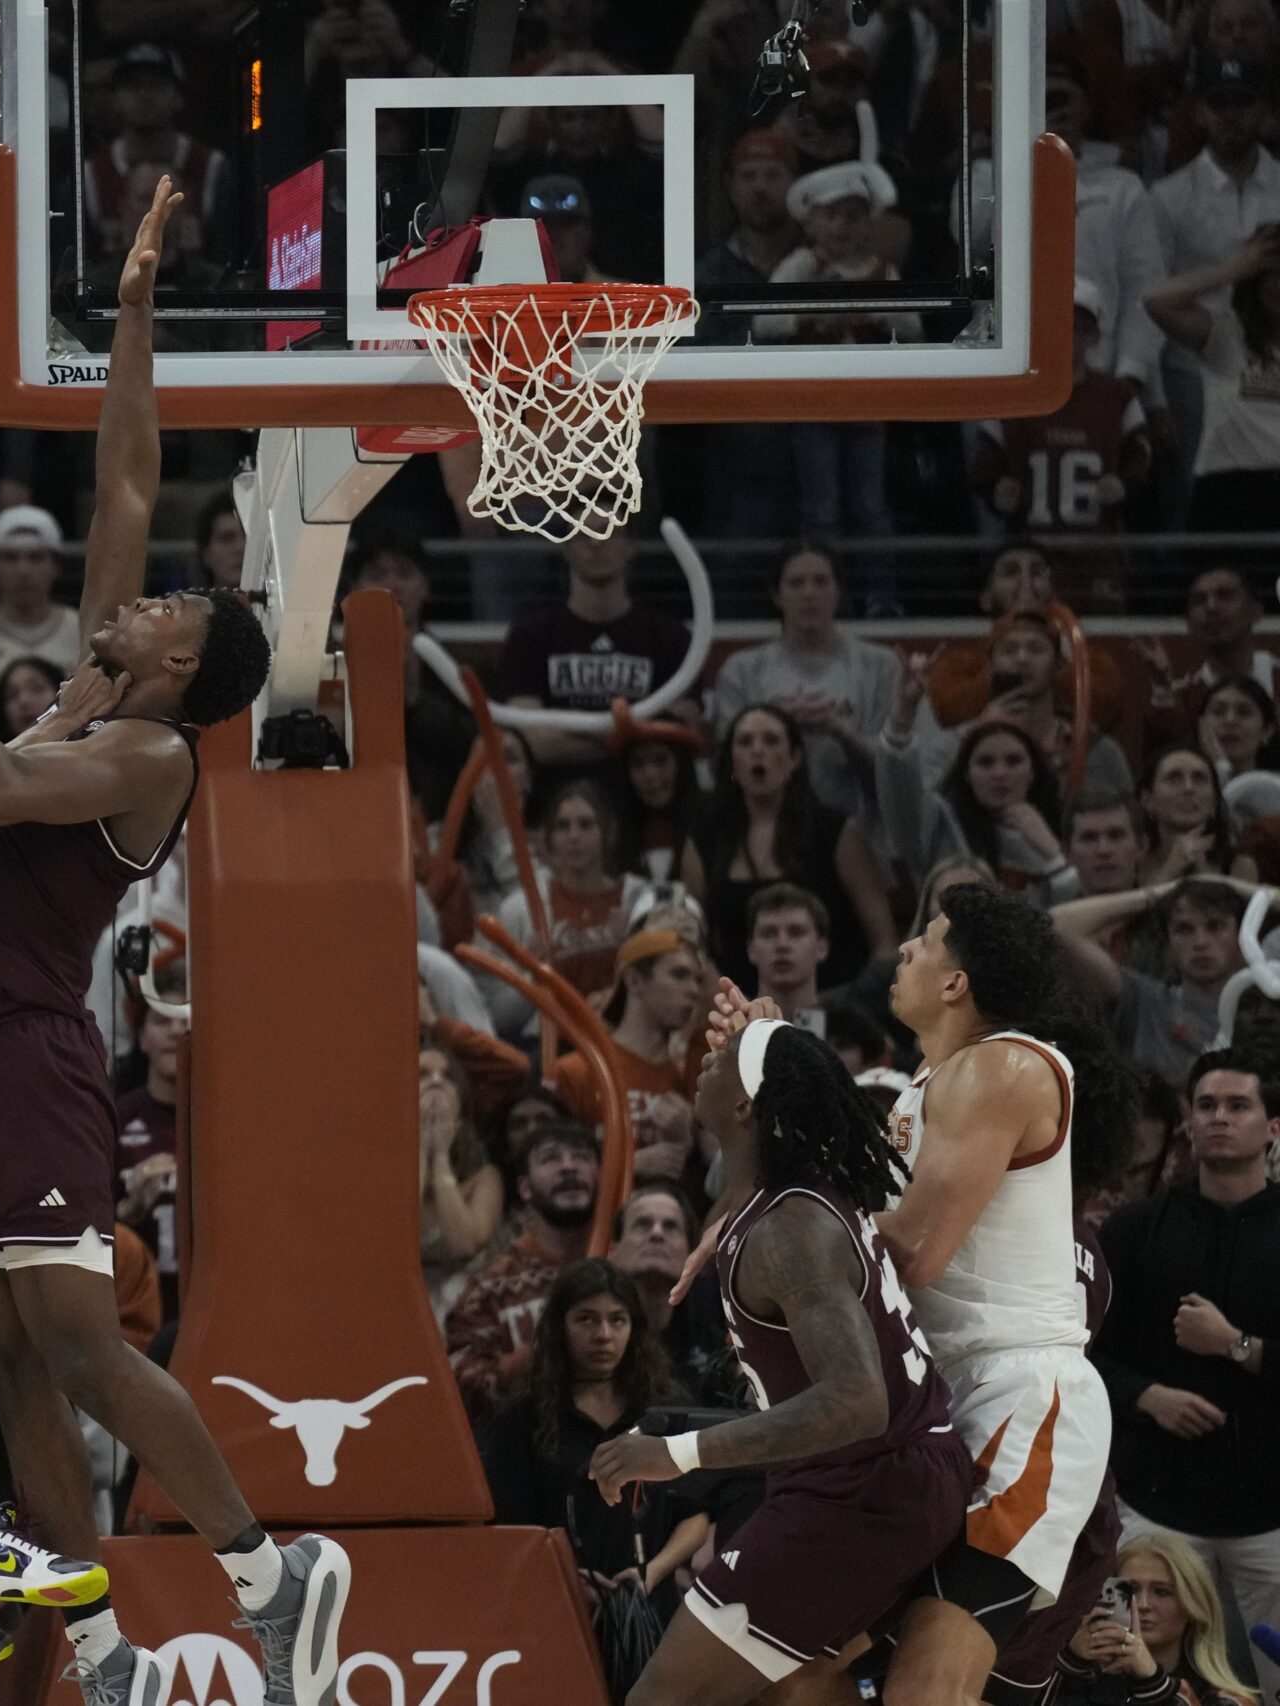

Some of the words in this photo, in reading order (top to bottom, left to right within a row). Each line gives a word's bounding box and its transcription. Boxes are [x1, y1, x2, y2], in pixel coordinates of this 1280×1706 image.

[48, 364, 109, 385] SPALD
[1025, 449, 1104, 525] 16
[336, 1650, 521, 1706] azr
